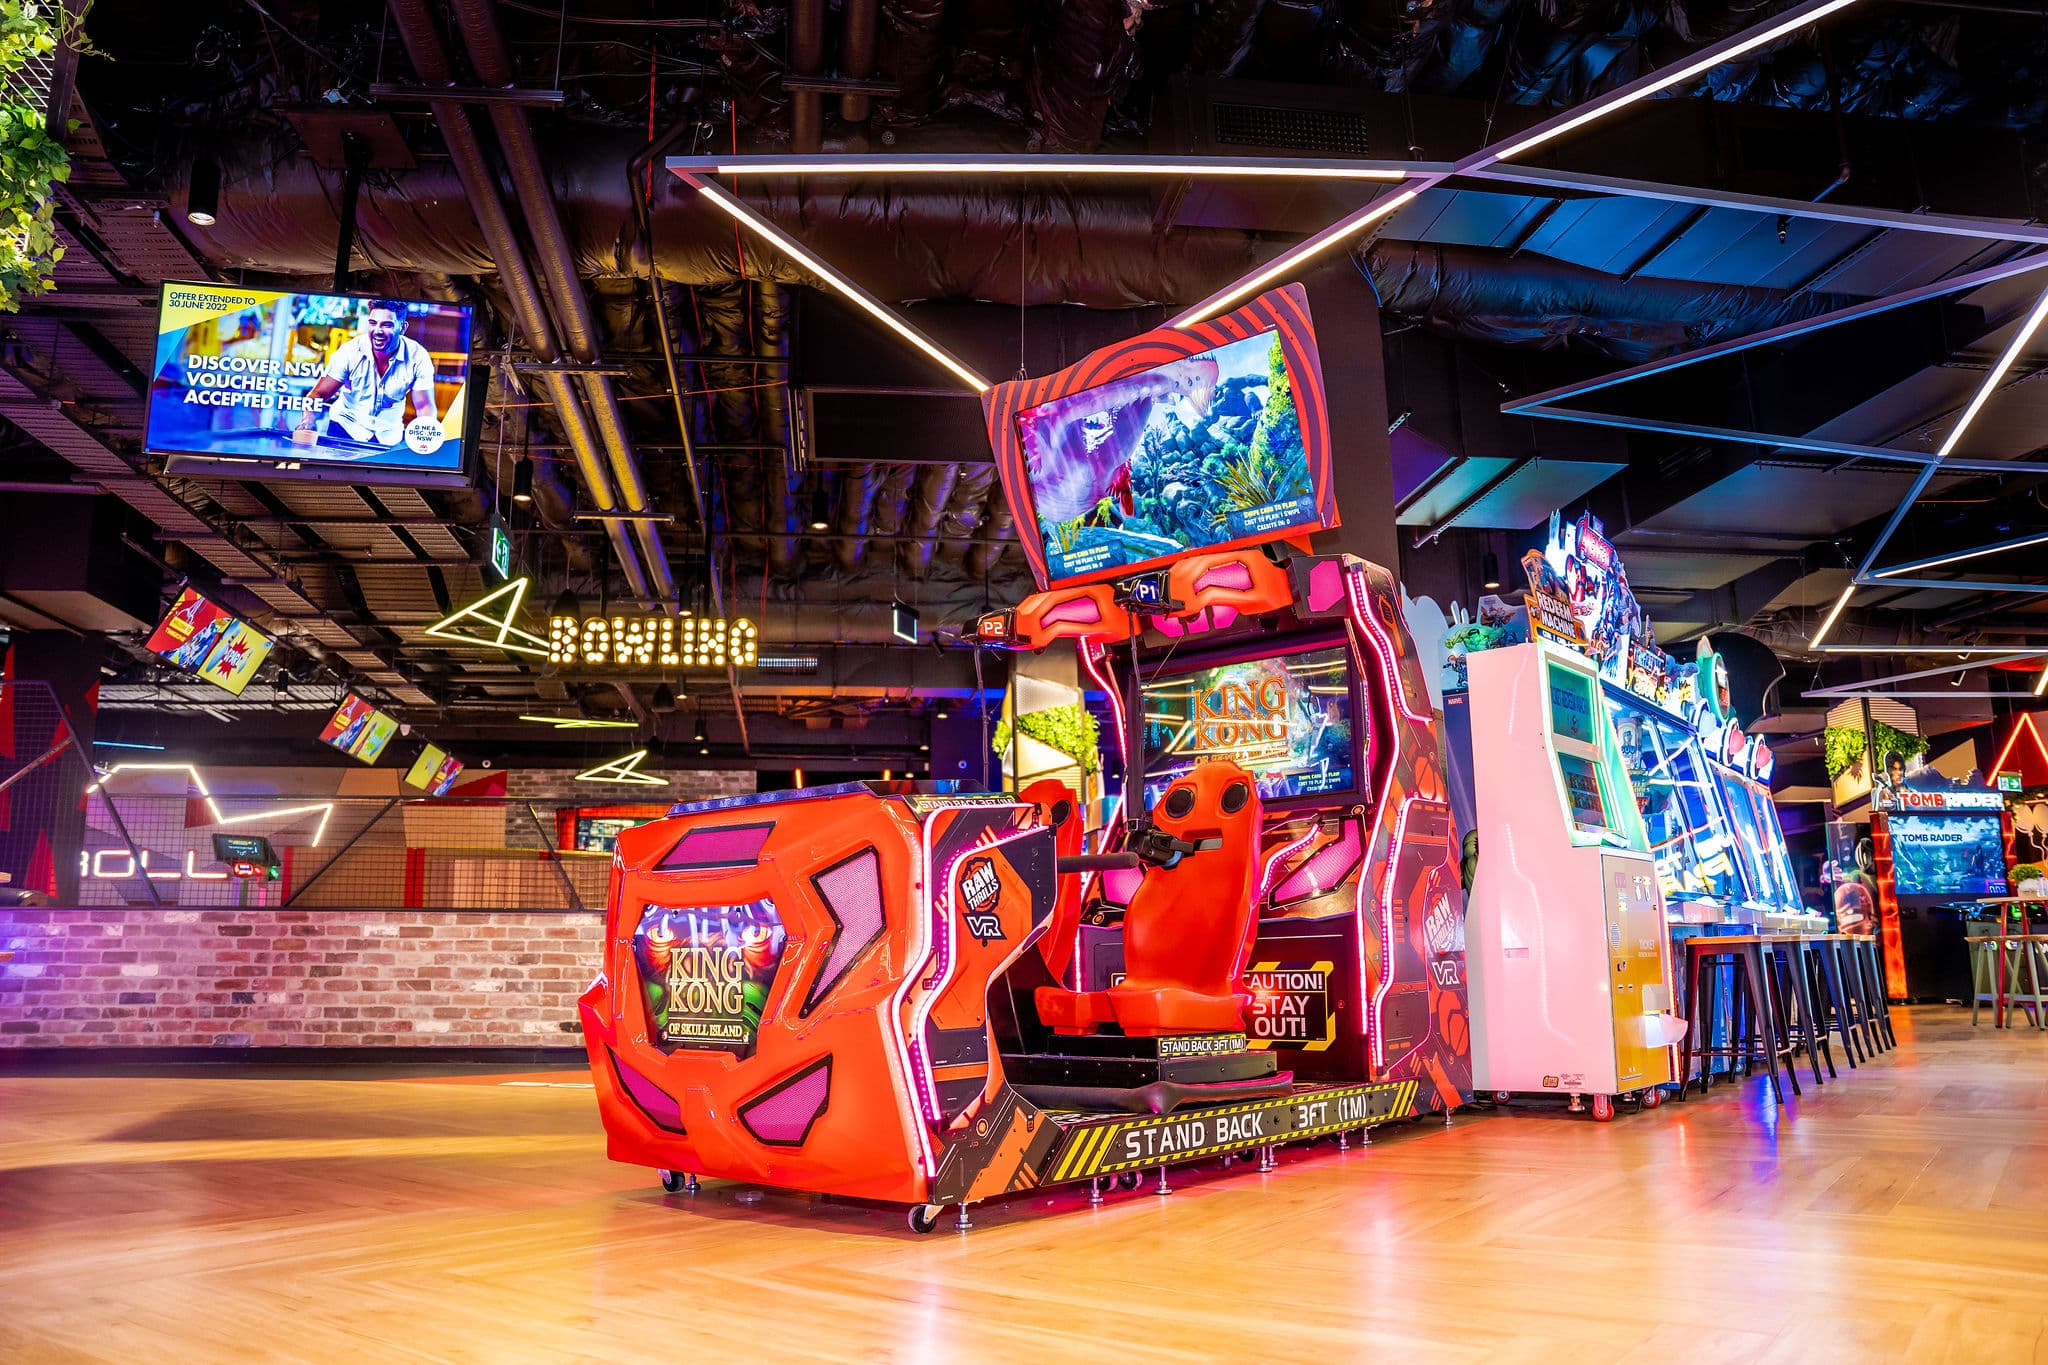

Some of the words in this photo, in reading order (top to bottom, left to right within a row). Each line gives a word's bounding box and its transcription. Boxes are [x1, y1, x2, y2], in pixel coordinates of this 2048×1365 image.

[169, 300, 182, 308] 30
[182, 302, 205, 310] JUNE
[206, 303, 228, 311] 2022
[170, 292, 198, 301] OFFER
[199, 294, 243, 304] EXTENDED
[244, 297, 256, 305] TO
[188, 354, 281, 375] DISCOVER
[284, 362, 329, 378] NSW
[186, 371, 289, 392] VOUCHERS
[183, 389, 276, 409] ACCEPTED
[278, 396, 324, 412] HERE
[408, 429, 442, 437] DISCVER
[1274, 504, 1282, 512] TO
[1139, 584, 1157, 600] P1
[1536, 590, 1573, 623] REDEEM
[984, 621, 1003, 635] P2
[1541, 608, 1577, 640] MACHINE
[548, 616, 758, 668] BOWLING
[1193, 676, 1287, 720] KING
[1193, 710, 1288, 749] KONG
[1899, 793, 1945, 808] TOMB
[1902, 834, 1929, 842] TOMB
[1930, 834, 1963, 842] RAIDER
[80, 850, 229, 878] OLL
[962, 861, 995, 901] RAW
[968, 878, 999, 910] THRILLS
[966, 916, 1002, 937] VR
[1425, 892, 1451, 942] RAW
[669, 946, 745, 985] KING
[1432, 960, 1460, 986] VR
[669, 981, 744, 1014] KONG
[1252, 995, 1310, 1015] STAY
[669, 1023, 681, 1035] OF
[681, 1024, 709, 1037] SKULL
[709, 1024, 743, 1038] ISLAND
[1254, 1017, 1307, 1037] OUT!
[1161, 1040, 1190, 1052] STAND
[1191, 1038, 1212, 1051] BACK
[1213, 1038, 1228, 1050] 3FT
[1229, 1036, 1244, 1049] (1M)
[1125, 1121, 1206, 1159] STAND
[1216, 1111, 1264, 1143] BACK
[1298, 1102, 1329, 1128] 3FT
[1337, 1094, 1368, 1123] (1M)
